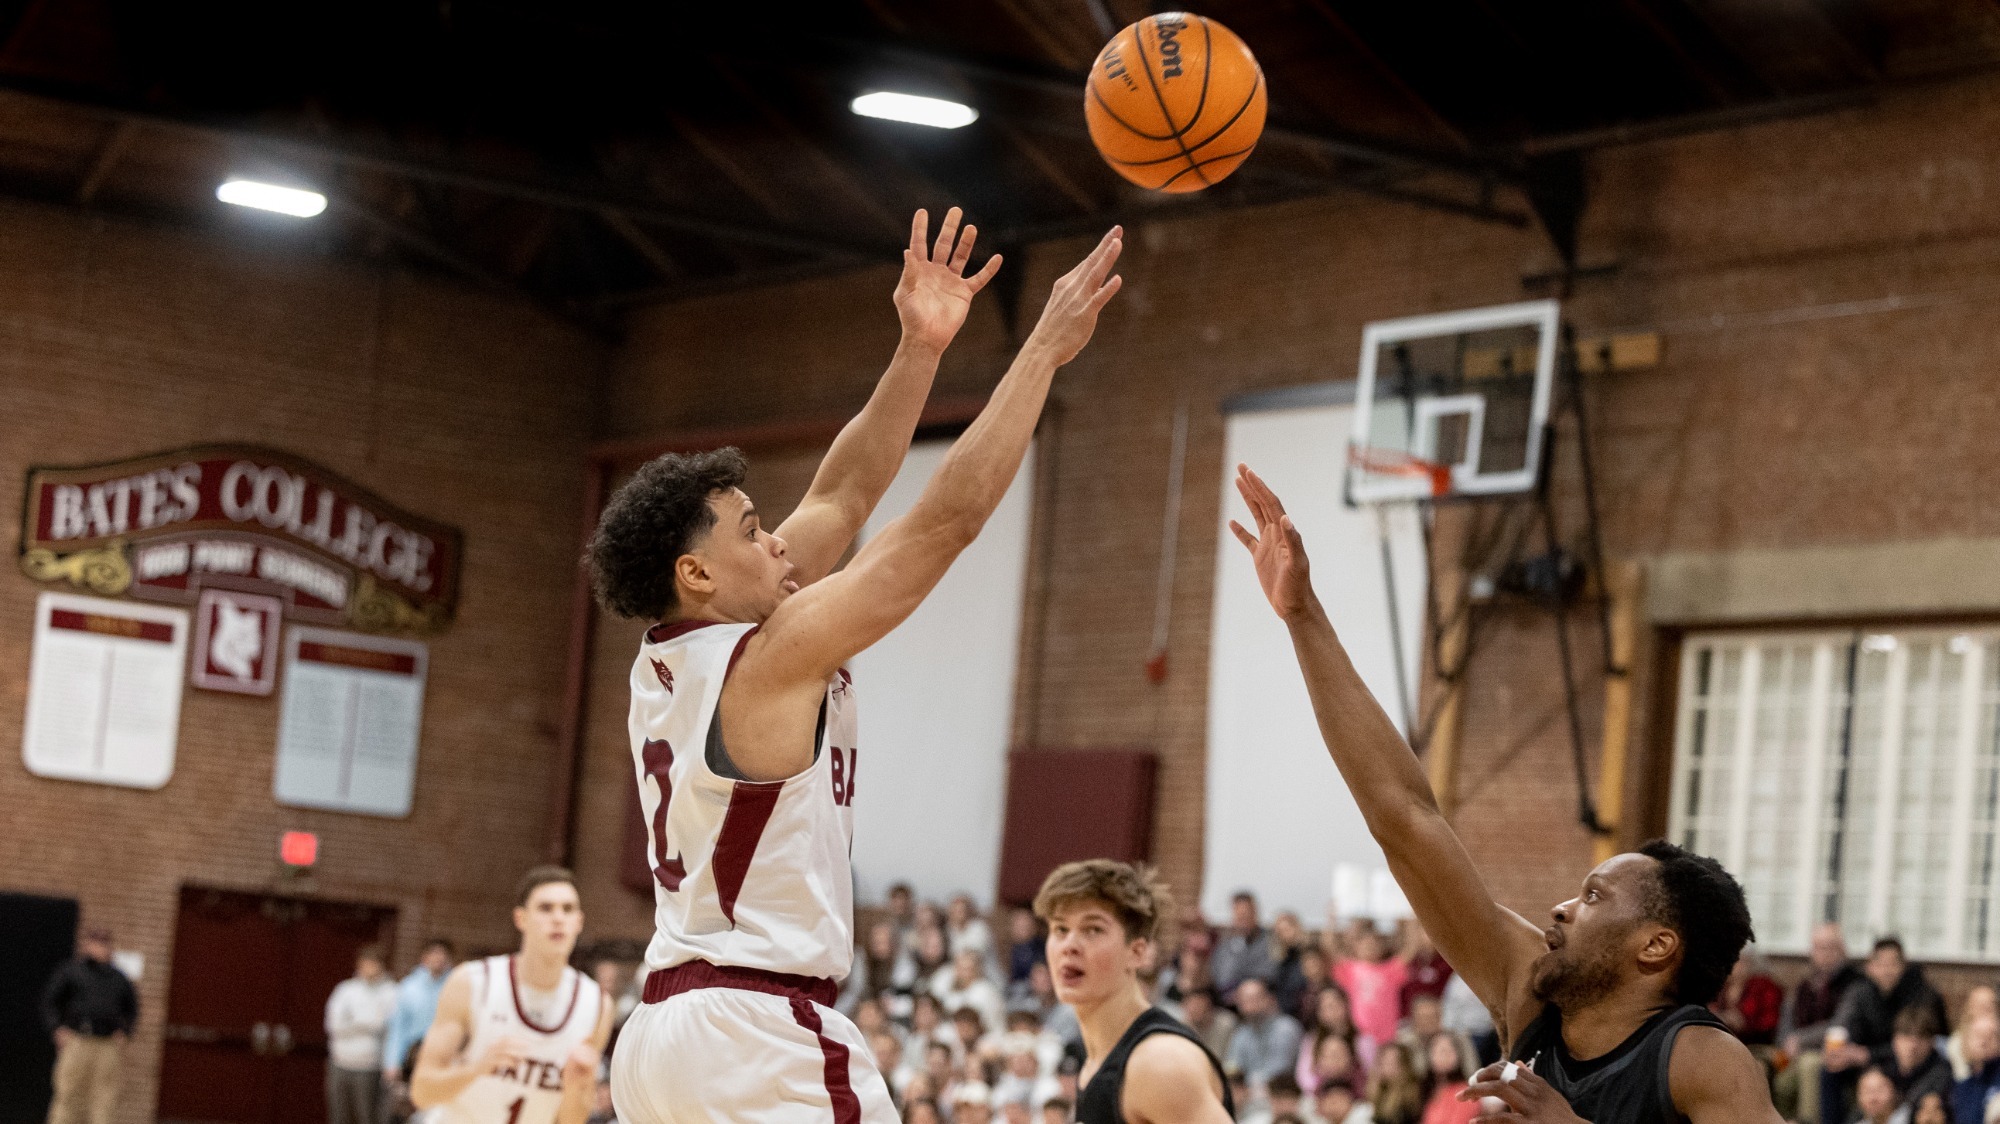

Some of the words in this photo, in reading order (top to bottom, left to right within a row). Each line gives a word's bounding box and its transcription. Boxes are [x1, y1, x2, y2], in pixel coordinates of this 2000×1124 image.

[1156, 17, 1188, 79] lson
[50, 462, 202, 540] BATES
[219, 460, 436, 591] COLLEGE
